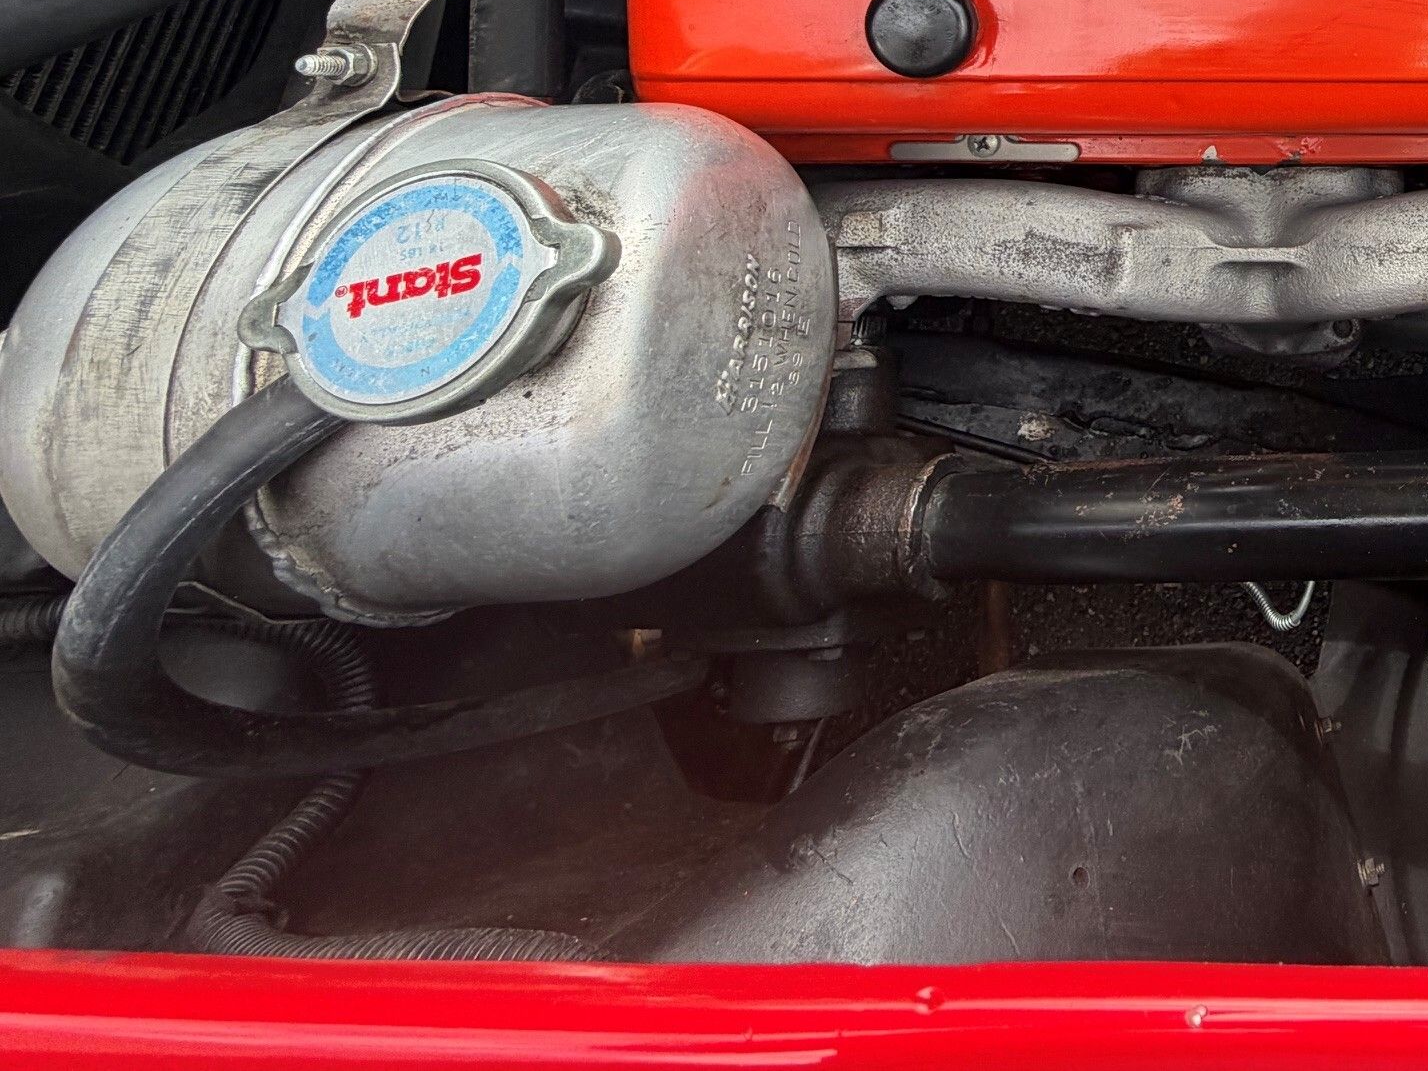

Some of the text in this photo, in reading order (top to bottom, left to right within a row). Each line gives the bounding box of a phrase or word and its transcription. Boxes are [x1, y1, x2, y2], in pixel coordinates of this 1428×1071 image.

[785, 219, 802, 282] COLD
[346, 251, 483, 321] Stant
[772, 289, 801, 370] WHEN
[740, 418, 773, 477] FILL
